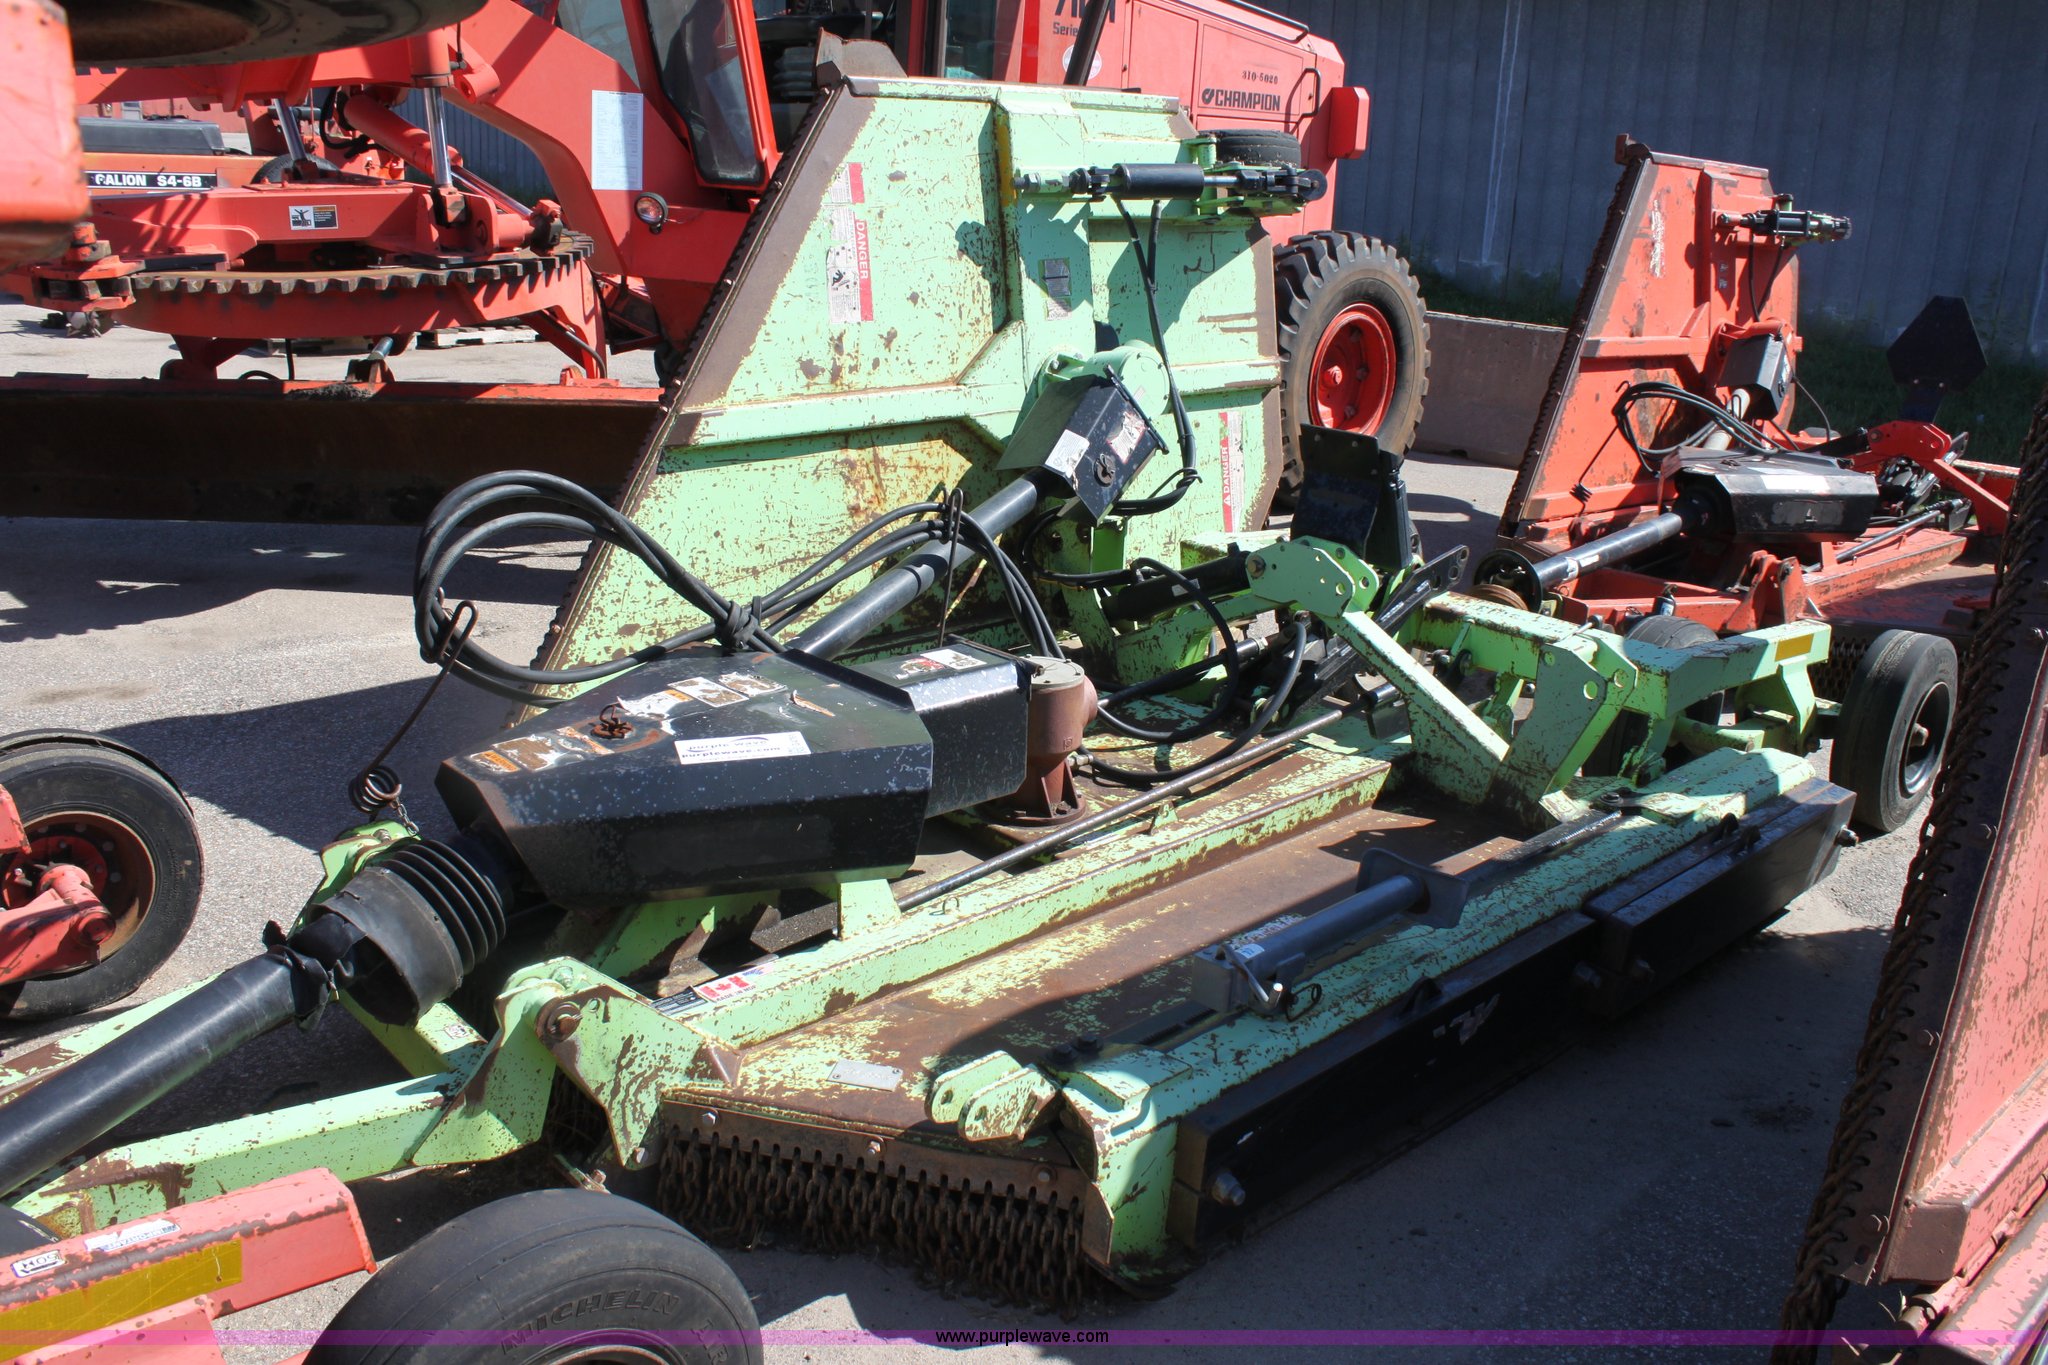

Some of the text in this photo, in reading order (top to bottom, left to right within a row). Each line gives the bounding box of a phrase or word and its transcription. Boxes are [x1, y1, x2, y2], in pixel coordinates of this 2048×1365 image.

[1053, 22, 1079, 36] Serie
[1215, 89, 1281, 111] CHAMPION
[157, 176, 202, 187] S4-6B
[856, 221, 869, 280] DANGER
[1222, 446, 1231, 493] DANGER
[501, 1289, 680, 1355] MICHELIN
